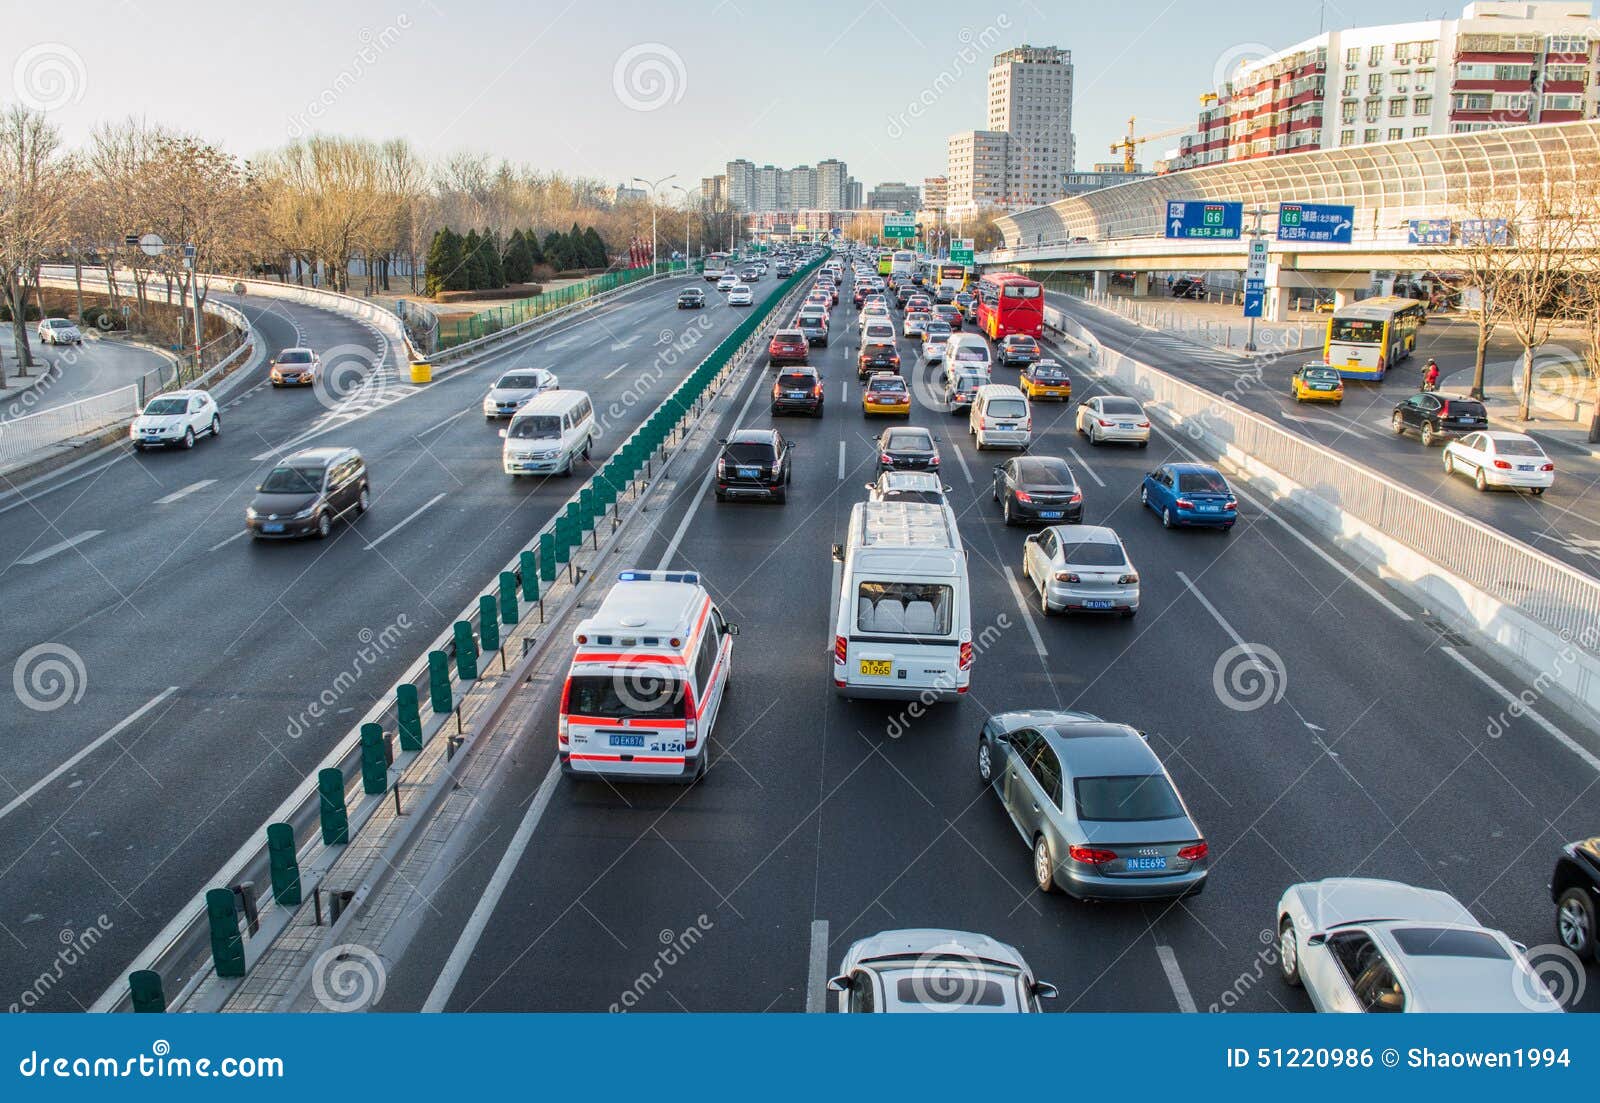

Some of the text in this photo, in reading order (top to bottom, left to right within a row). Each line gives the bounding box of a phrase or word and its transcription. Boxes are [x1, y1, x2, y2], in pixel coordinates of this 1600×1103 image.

[1207, 212, 1221, 223] G6
[1285, 212, 1298, 223] G6
[861, 665, 890, 675] 01965
[610, 734, 644, 747] QEK876
[661, 742, 685, 753] 120
